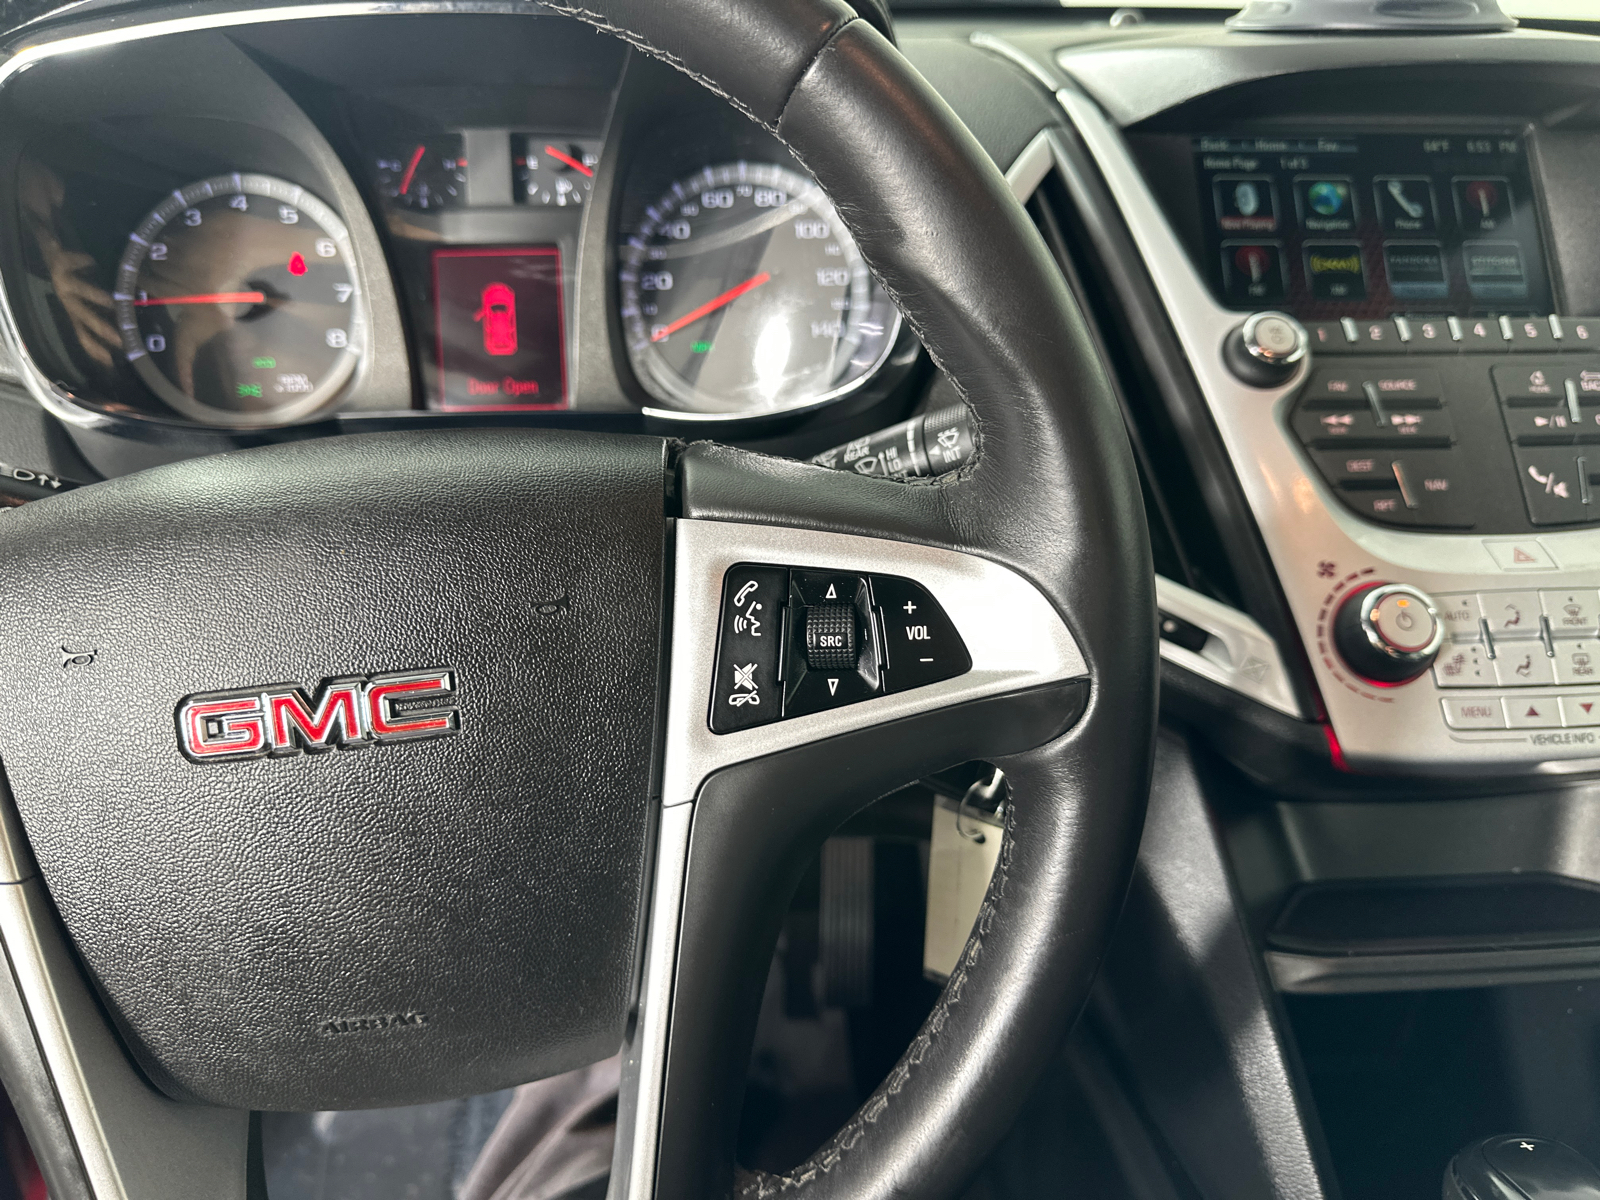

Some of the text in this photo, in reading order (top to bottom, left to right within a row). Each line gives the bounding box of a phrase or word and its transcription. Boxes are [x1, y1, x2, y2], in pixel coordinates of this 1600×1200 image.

[229, 195, 248, 211] 4
[702, 189, 733, 208] 60
[754, 187, 786, 208] 80
[184, 208, 202, 227] 3
[278, 205, 298, 224] 5
[795, 220, 830, 239] 100
[151, 242, 168, 260] 2
[315, 238, 337, 257] 6
[816, 268, 849, 287] 120
[333, 282, 352, 303] 7
[1369, 324, 1383, 340] 2
[1422, 323, 1436, 339] 3
[1474, 322, 1487, 337] 4
[1524, 322, 1538, 338] 5
[1576, 325, 1589, 340] 6
[147, 334, 166, 352] 0
[325, 328, 347, 348] 8
[467, 377, 539, 396] Door Open
[1378, 379, 1417, 391] SOURCE
[1581, 380, 1600, 391] BAC
[885, 446, 898, 461] HI
[942, 446, 961, 463] INT
[887, 458, 901, 473] LO
[1444, 611, 1470, 621] AUTO
[1562, 616, 1587, 626] FRONT
[906, 626, 931, 640] VOL
[819, 635, 842, 648] SRC
[1572, 667, 1593, 676] REAR
[176, 668, 460, 763] GMC
[1461, 706, 1491, 718] MENU
[1530, 732, 1595, 746] VEHICLE INFO
